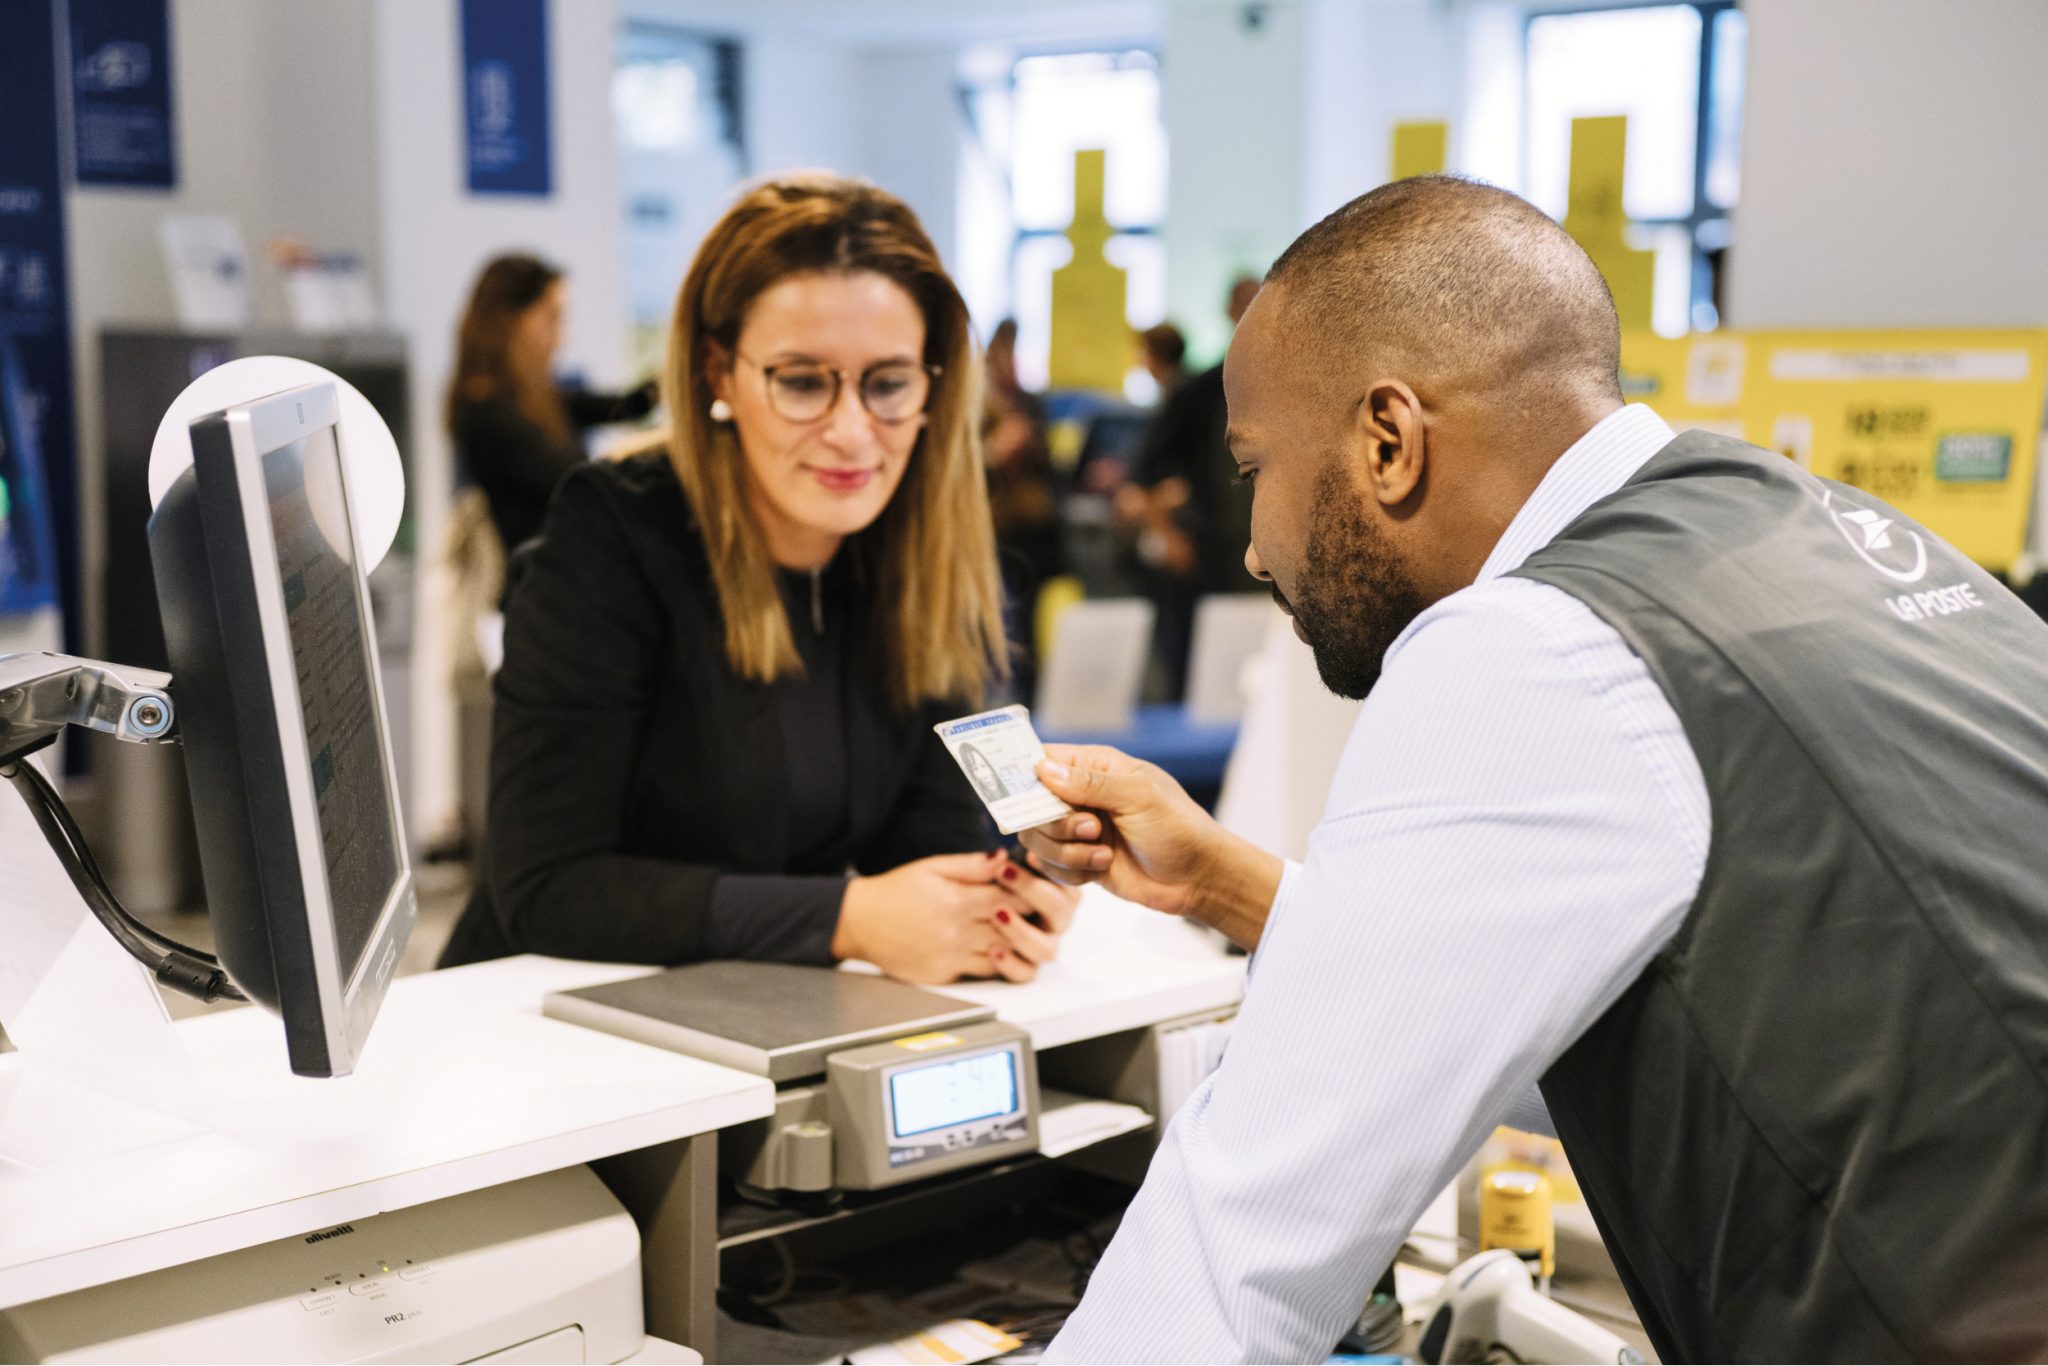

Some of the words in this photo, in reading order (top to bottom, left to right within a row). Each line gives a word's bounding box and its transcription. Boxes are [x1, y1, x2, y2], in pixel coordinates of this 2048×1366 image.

[1884, 594, 1925, 621] LA
[1913, 583, 1984, 618] POSTE
[304, 1224, 355, 1244] olivetti
[384, 1312, 406, 1325] PR2
